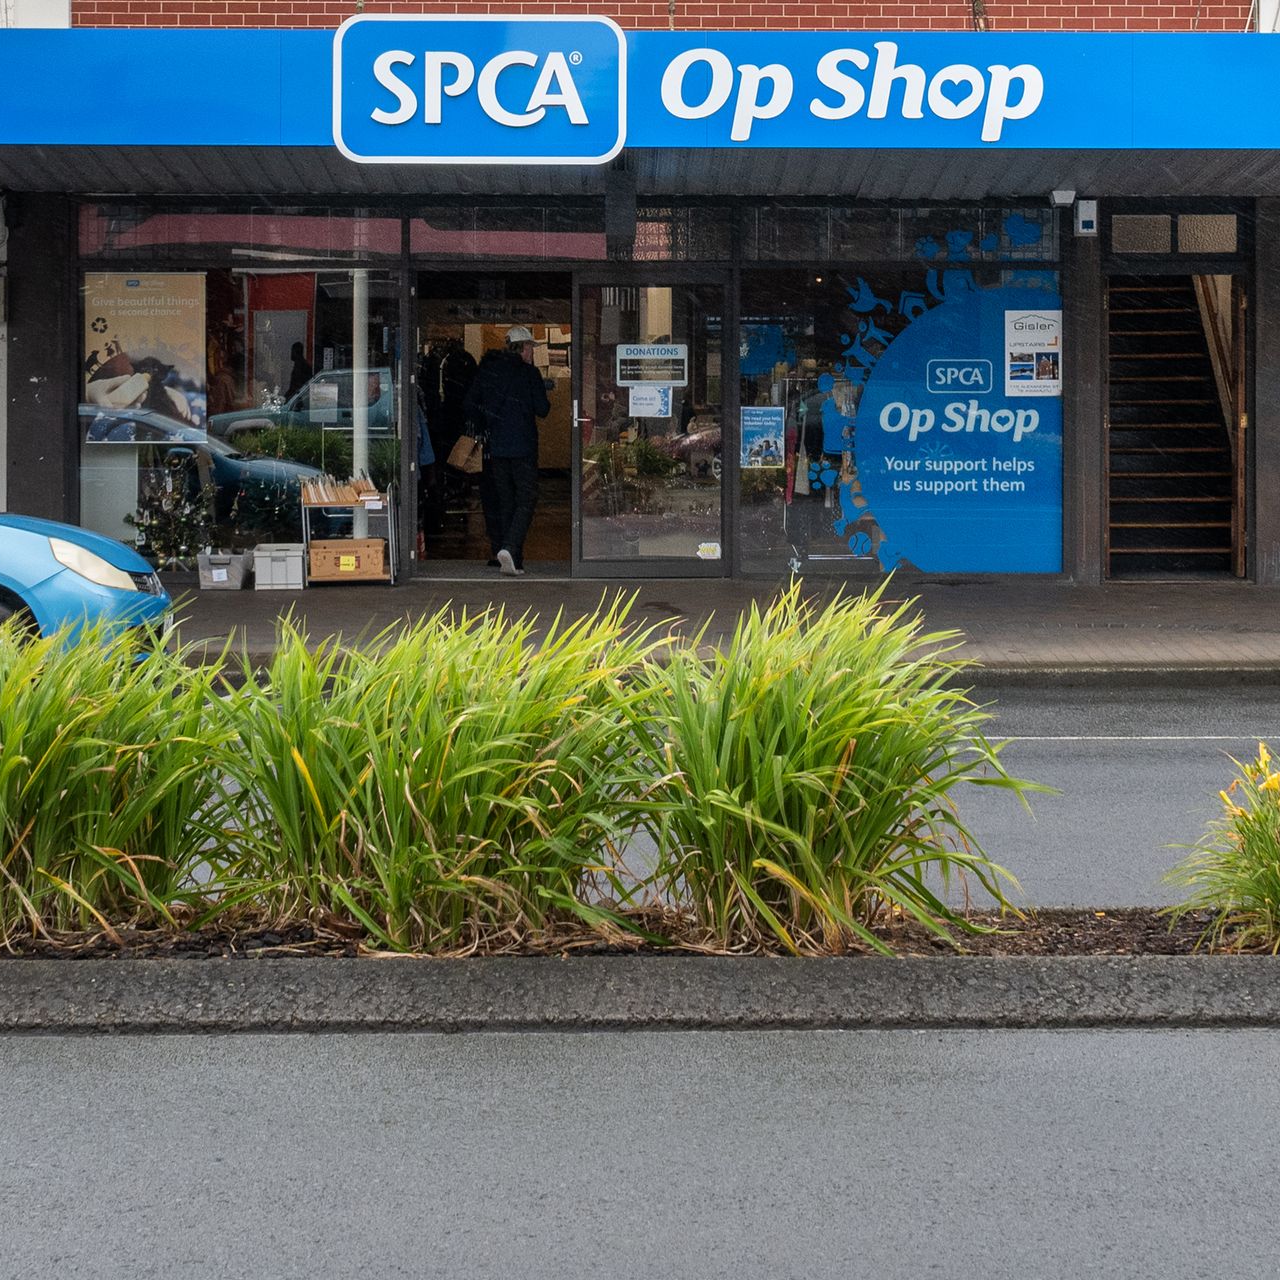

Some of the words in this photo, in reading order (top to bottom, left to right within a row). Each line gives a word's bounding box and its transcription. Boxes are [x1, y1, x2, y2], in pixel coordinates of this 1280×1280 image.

[661, 47, 794, 142] Op
[810, 41, 1044, 143] Shop
[91, 297, 115, 306] Give
[117, 296, 164, 307] beautiful
[167, 297, 200, 308] things
[118, 308, 149, 316] second
[151, 308, 182, 316] chance
[1014, 321, 1054, 331] Gisler
[625, 347, 679, 356] DONATIONS
[935, 367, 984, 385] SPCA
[879, 401, 936, 442] Op
[941, 399, 1040, 443] Shop
[884, 456, 921, 472] Your
[925, 458, 988, 475] support
[992, 456, 1035, 476] helps
[893, 480, 911, 492] us
[915, 479, 978, 496] support
[982, 477, 1025, 492] them
